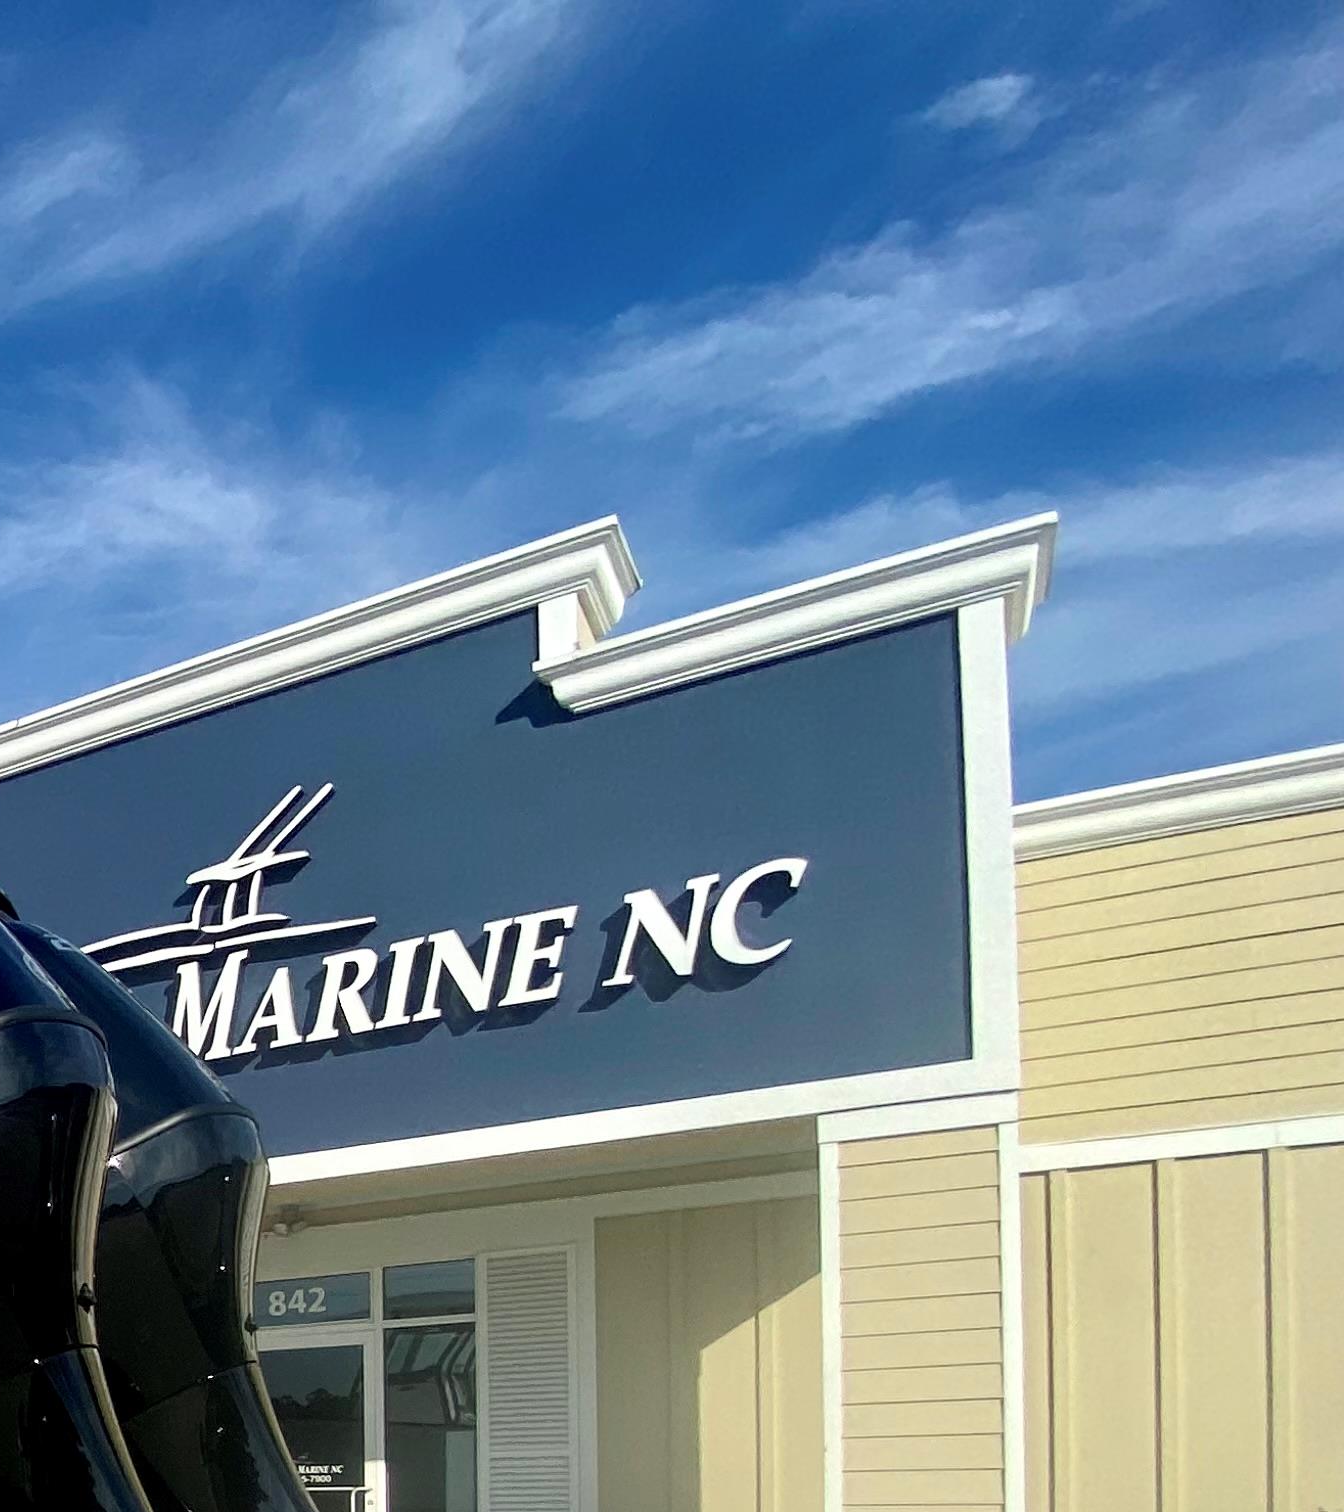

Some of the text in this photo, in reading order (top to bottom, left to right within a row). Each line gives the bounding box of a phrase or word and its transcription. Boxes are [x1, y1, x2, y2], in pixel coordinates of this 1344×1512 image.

[173, 905, 579, 1062] MARINE
[602, 857, 809, 988] NC
[267, 1286, 327, 1317] 842
